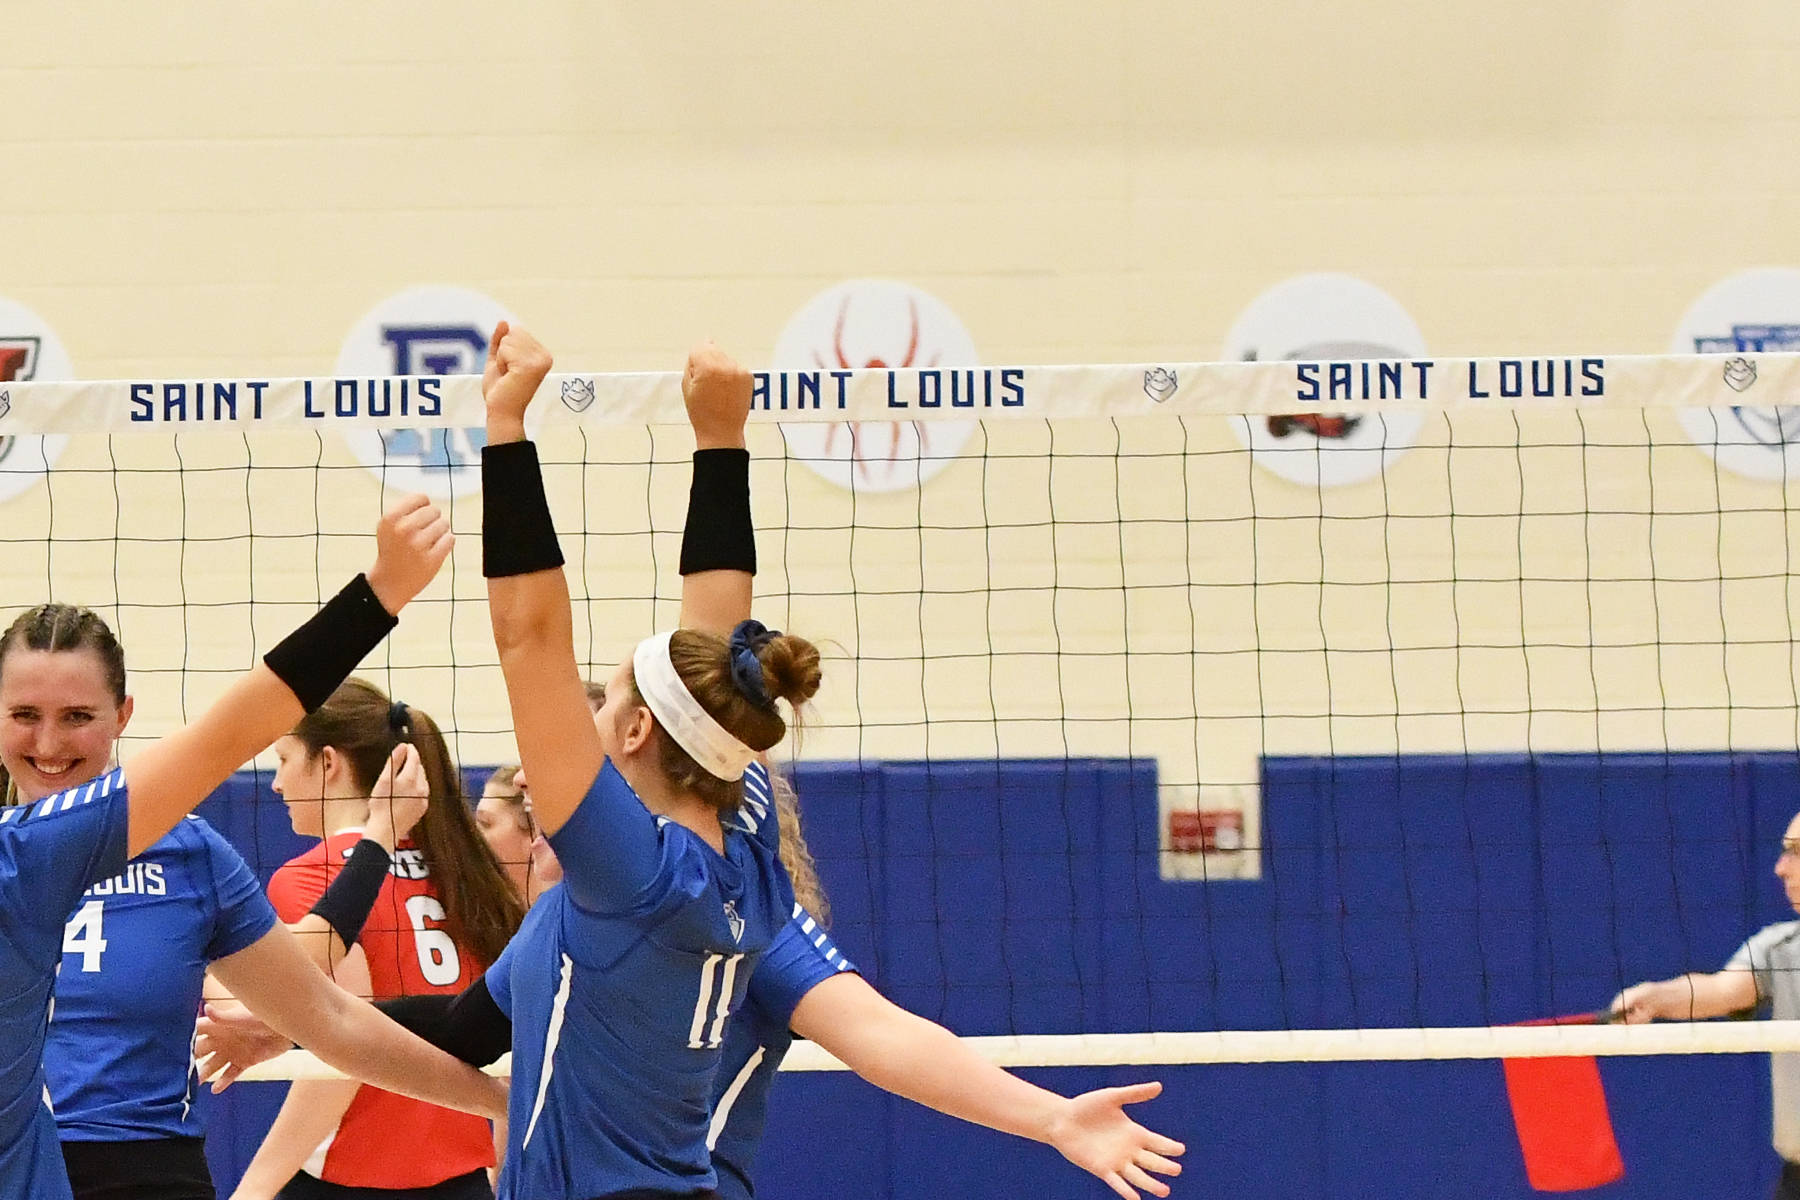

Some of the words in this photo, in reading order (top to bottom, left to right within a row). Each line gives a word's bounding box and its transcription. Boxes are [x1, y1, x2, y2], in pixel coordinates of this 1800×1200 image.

[130, 382, 269, 422] SAINT
[304, 379, 442, 418] LOUIS
[750, 371, 853, 410] AINT
[887, 369, 1025, 408] LOUIS
[1296, 361, 1434, 401] SAINT
[1468, 358, 1605, 398] LOUIS
[83, 862, 167, 896] UIS
[61, 900, 108, 972] 4
[404, 895, 460, 986] 6
[687, 953, 745, 1048] 11
